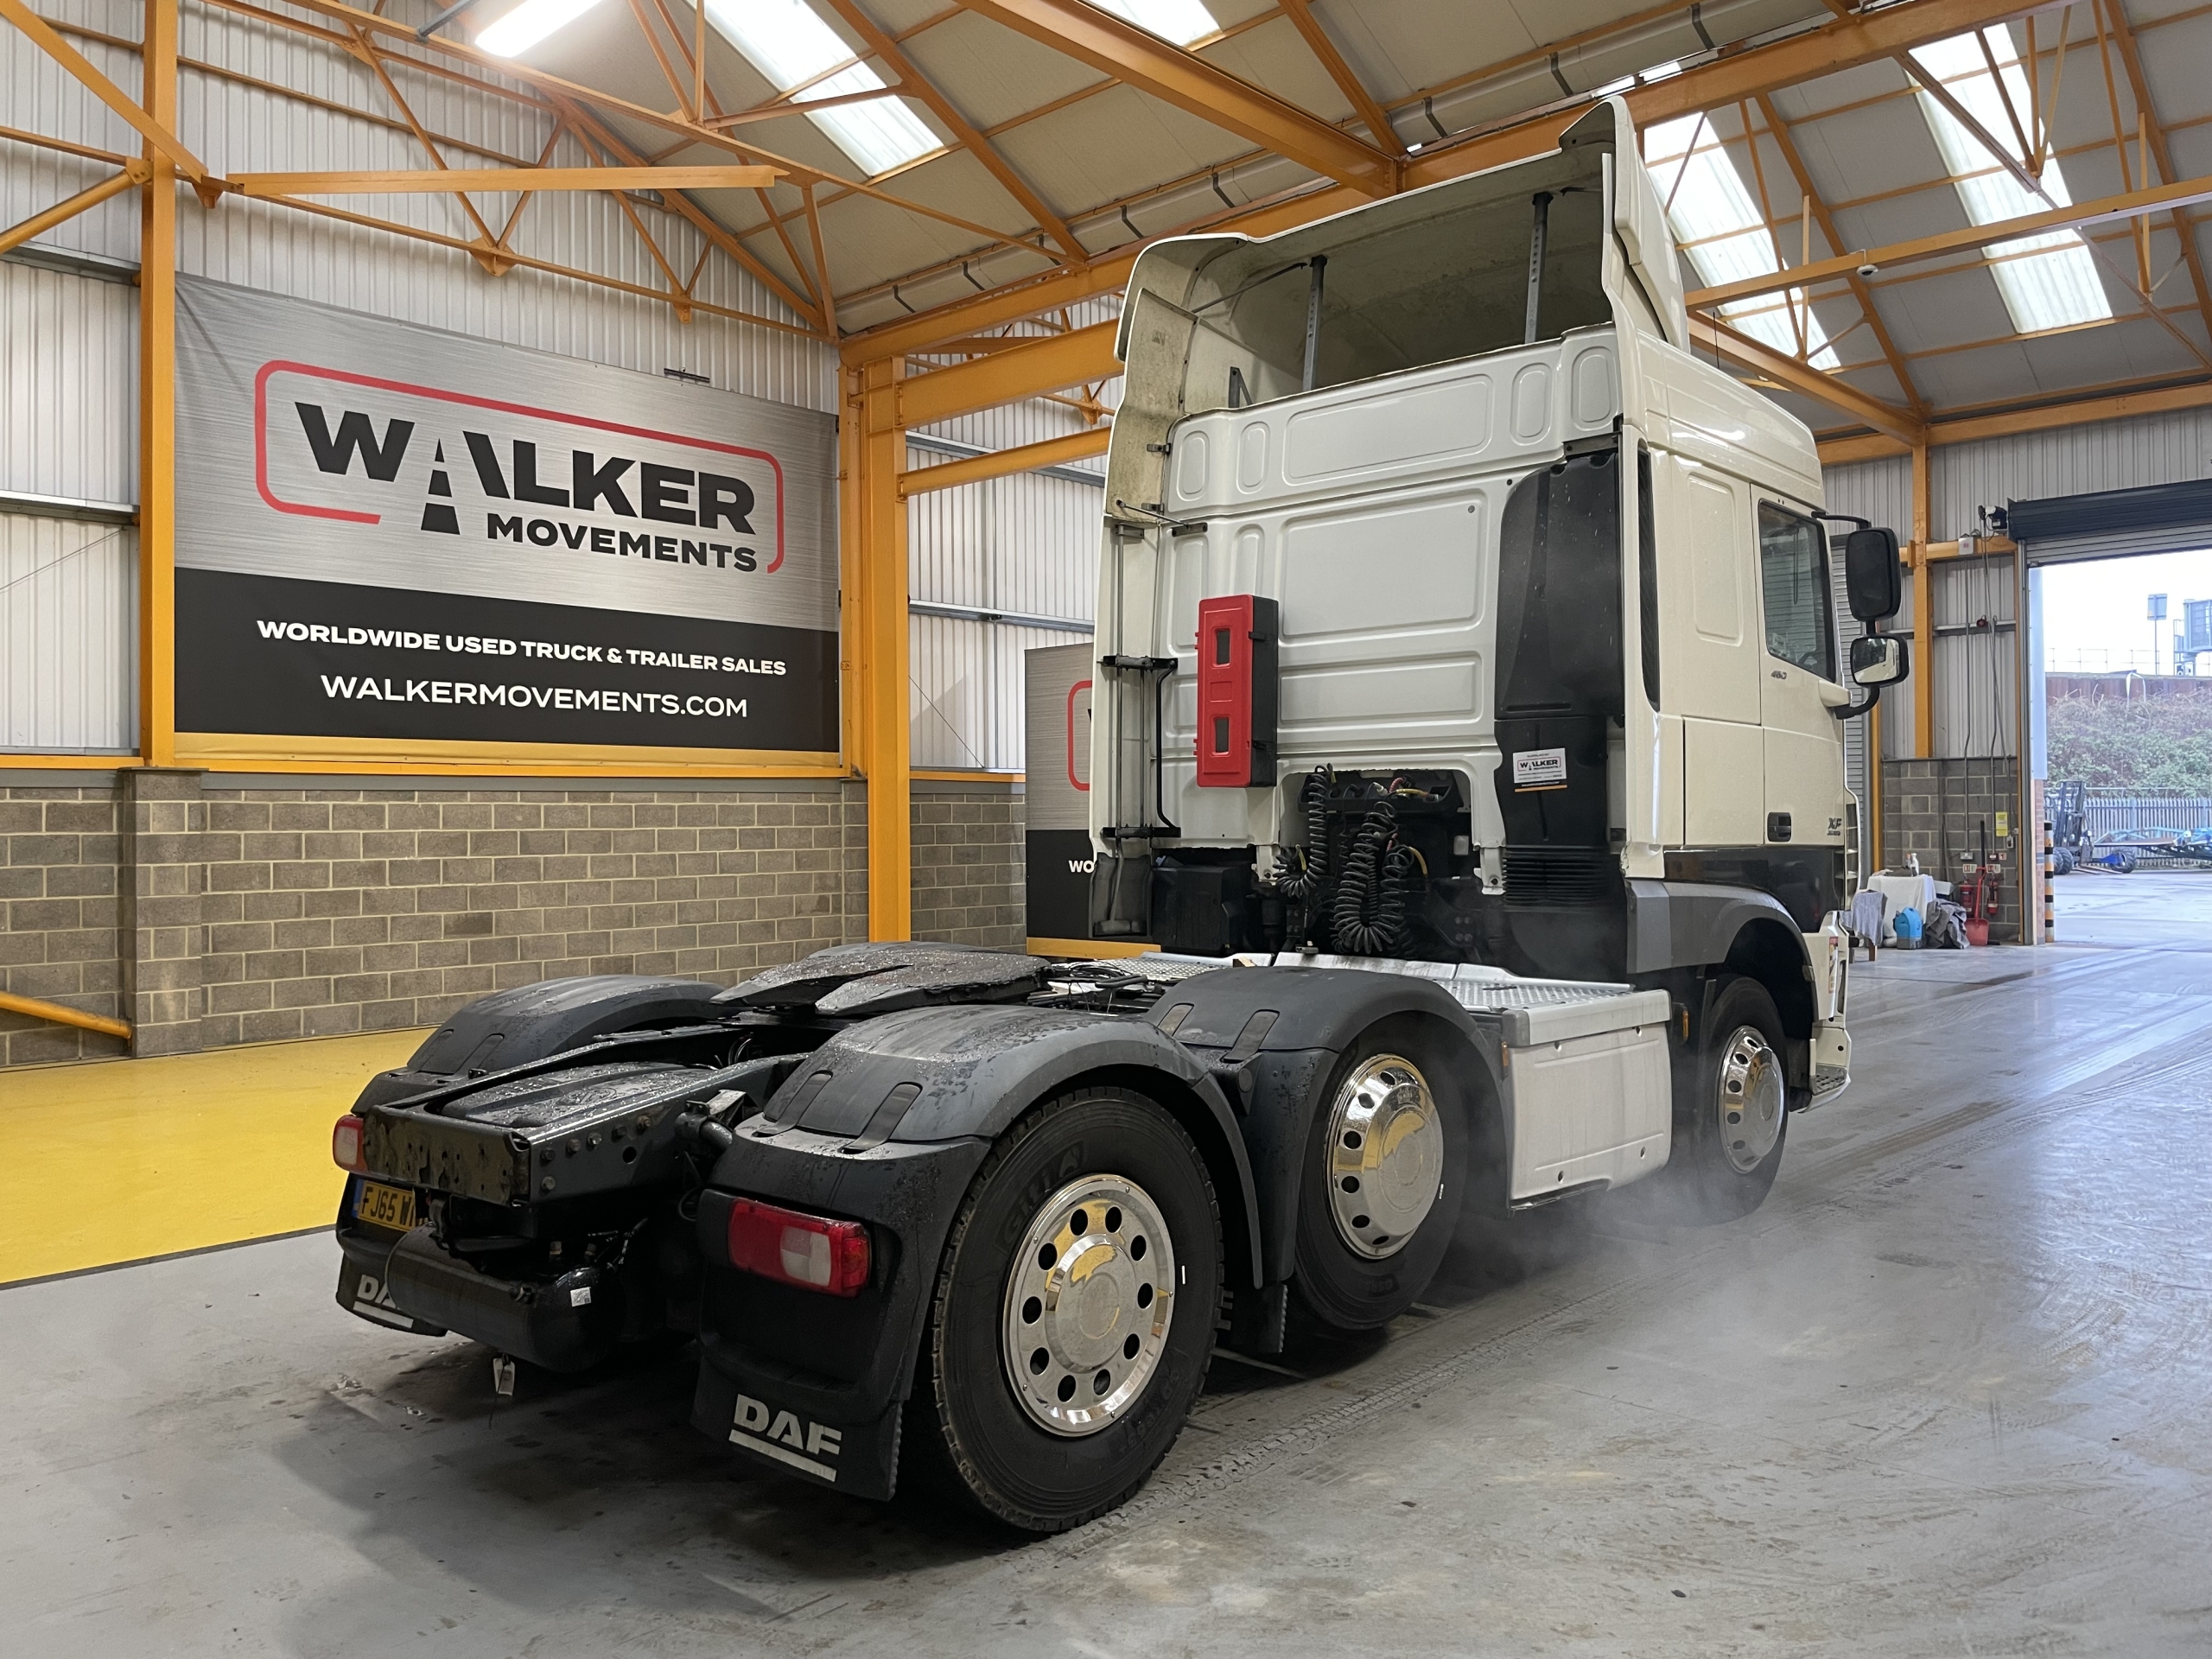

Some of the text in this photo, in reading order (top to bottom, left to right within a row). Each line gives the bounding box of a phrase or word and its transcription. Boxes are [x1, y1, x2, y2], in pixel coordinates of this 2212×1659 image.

[294, 401, 757, 536] WALKER
[486, 512, 757, 572] MOVEMENTS
[257, 620, 786, 676] WORLDWIDE USED TRUCK & TRAILER SALES
[321, 674, 747, 718] WALKERMOVEMENTS.COM
[1520, 760, 1558, 771] WALKER
[1827, 817, 1842, 830] XF
[1068, 860, 1095, 873] WO
[361, 1186, 397, 1223] FJ65
[733, 1393, 842, 1455] DAF
